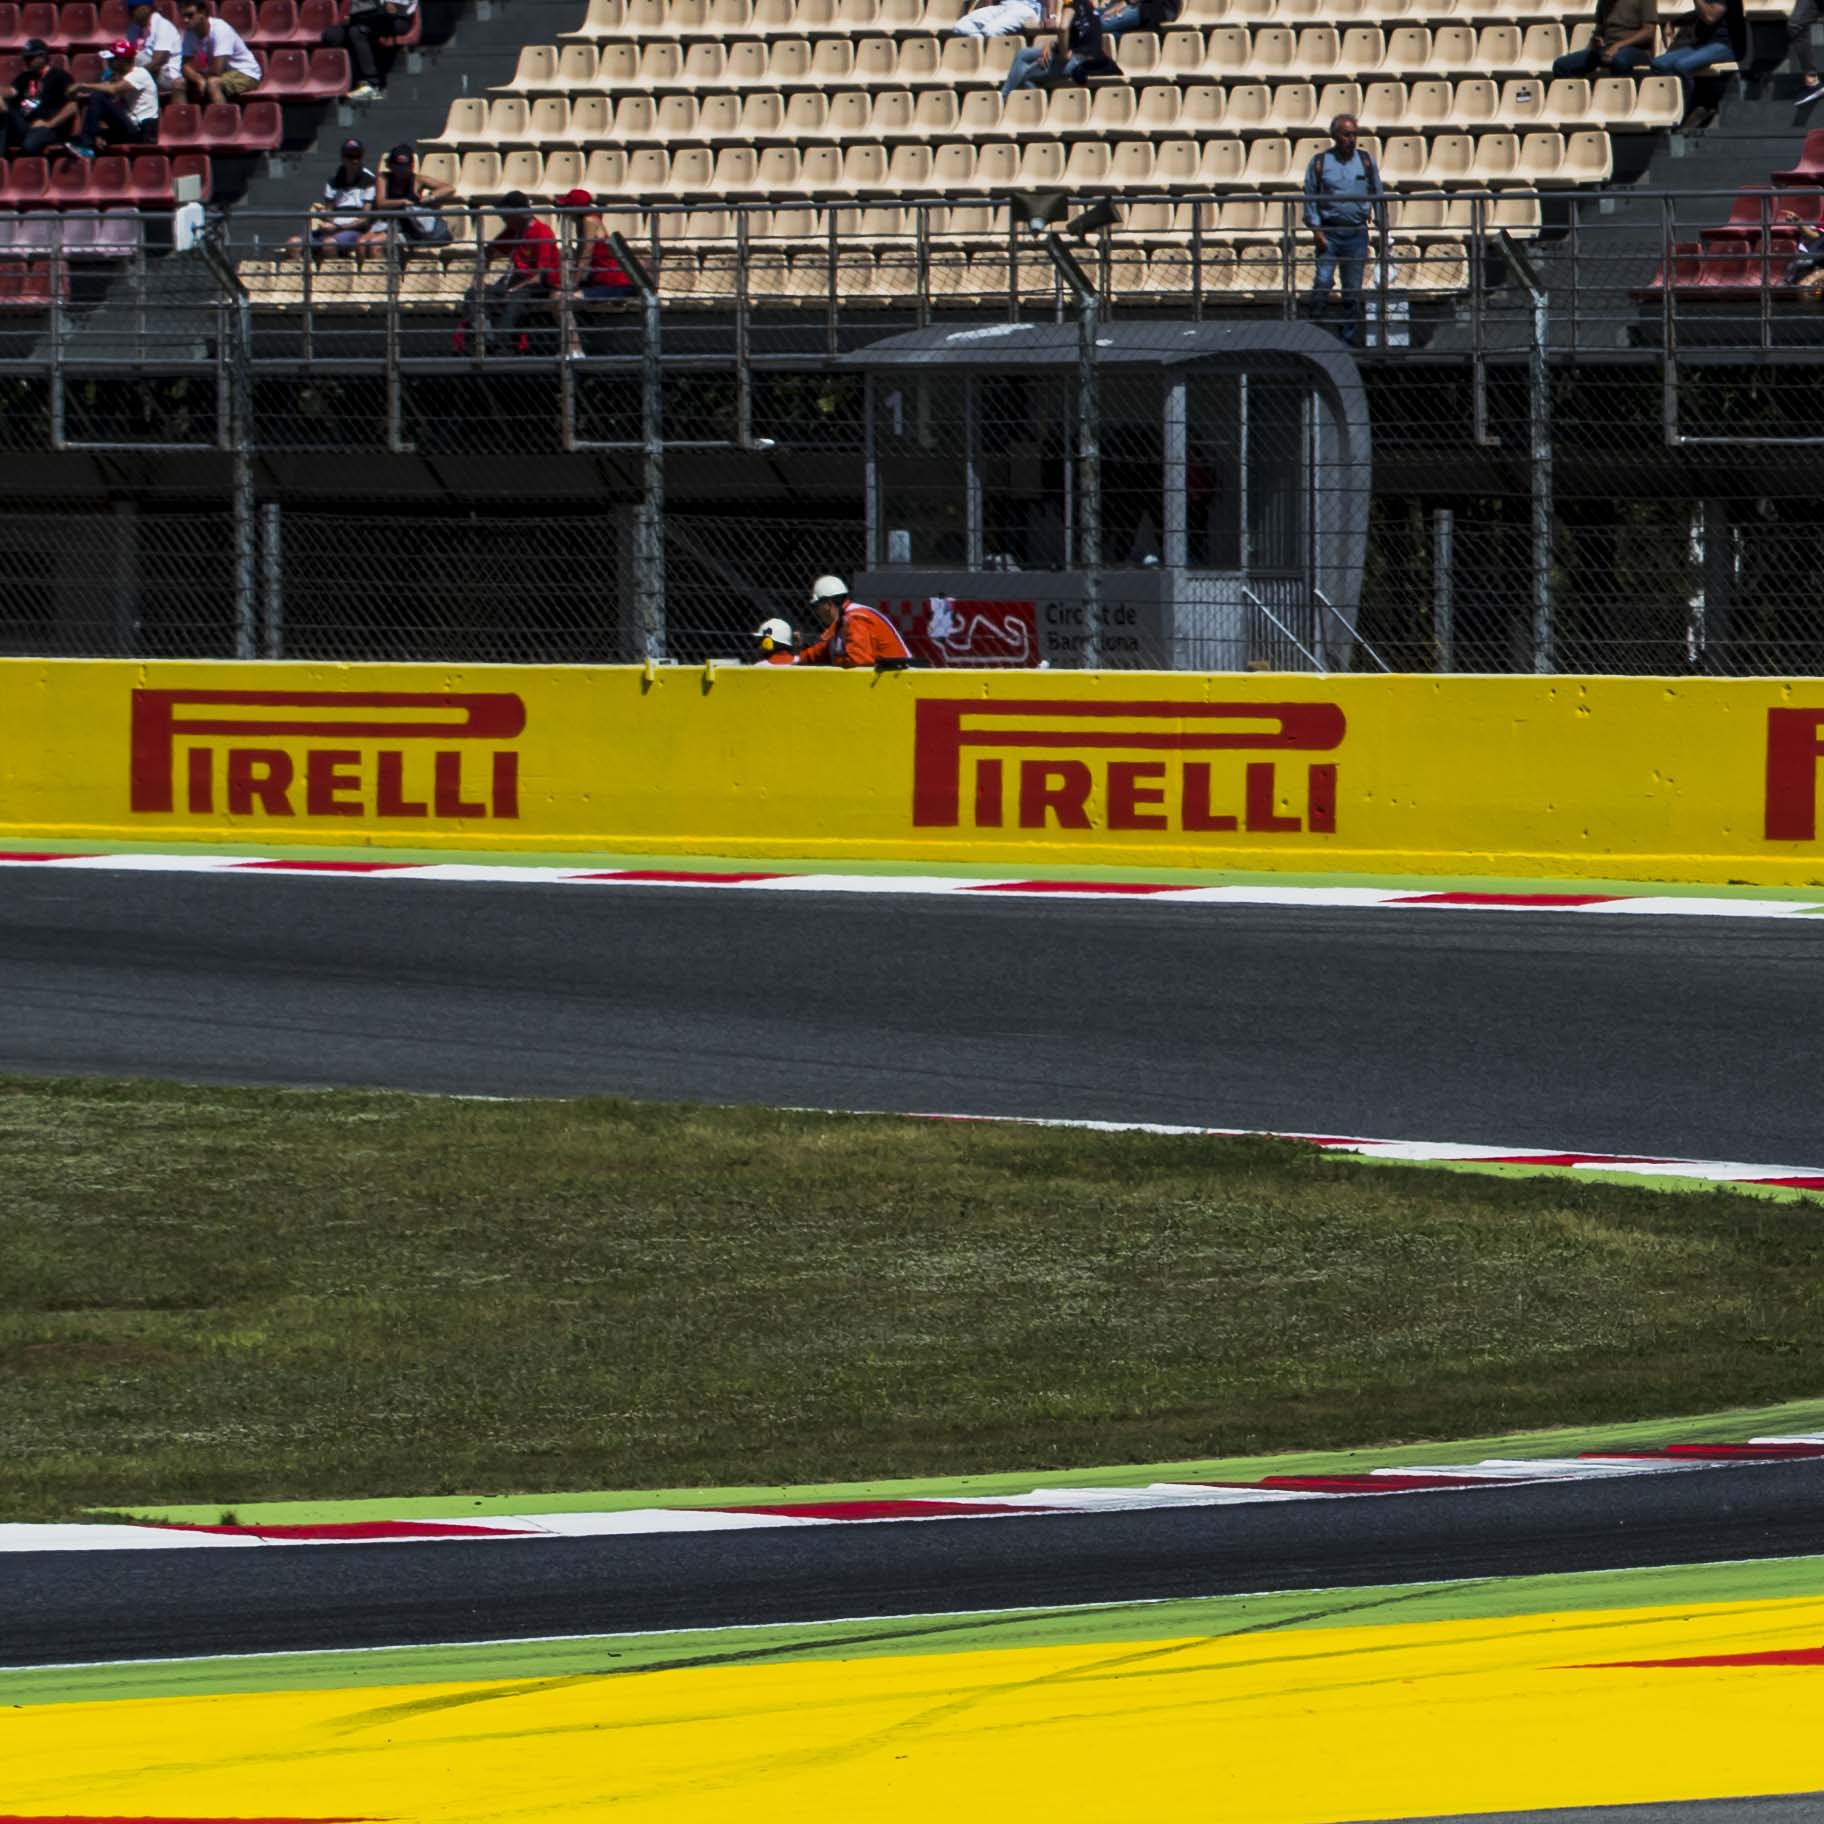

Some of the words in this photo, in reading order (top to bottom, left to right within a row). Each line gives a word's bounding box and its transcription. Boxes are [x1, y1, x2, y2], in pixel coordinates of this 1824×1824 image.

[885, 391, 903, 436] 1
[1045, 602, 1110, 625] Circt
[1114, 603, 1136, 625] de
[131, 689, 526, 821] PIRELLI
[914, 699, 1346, 835] PIRELLI
